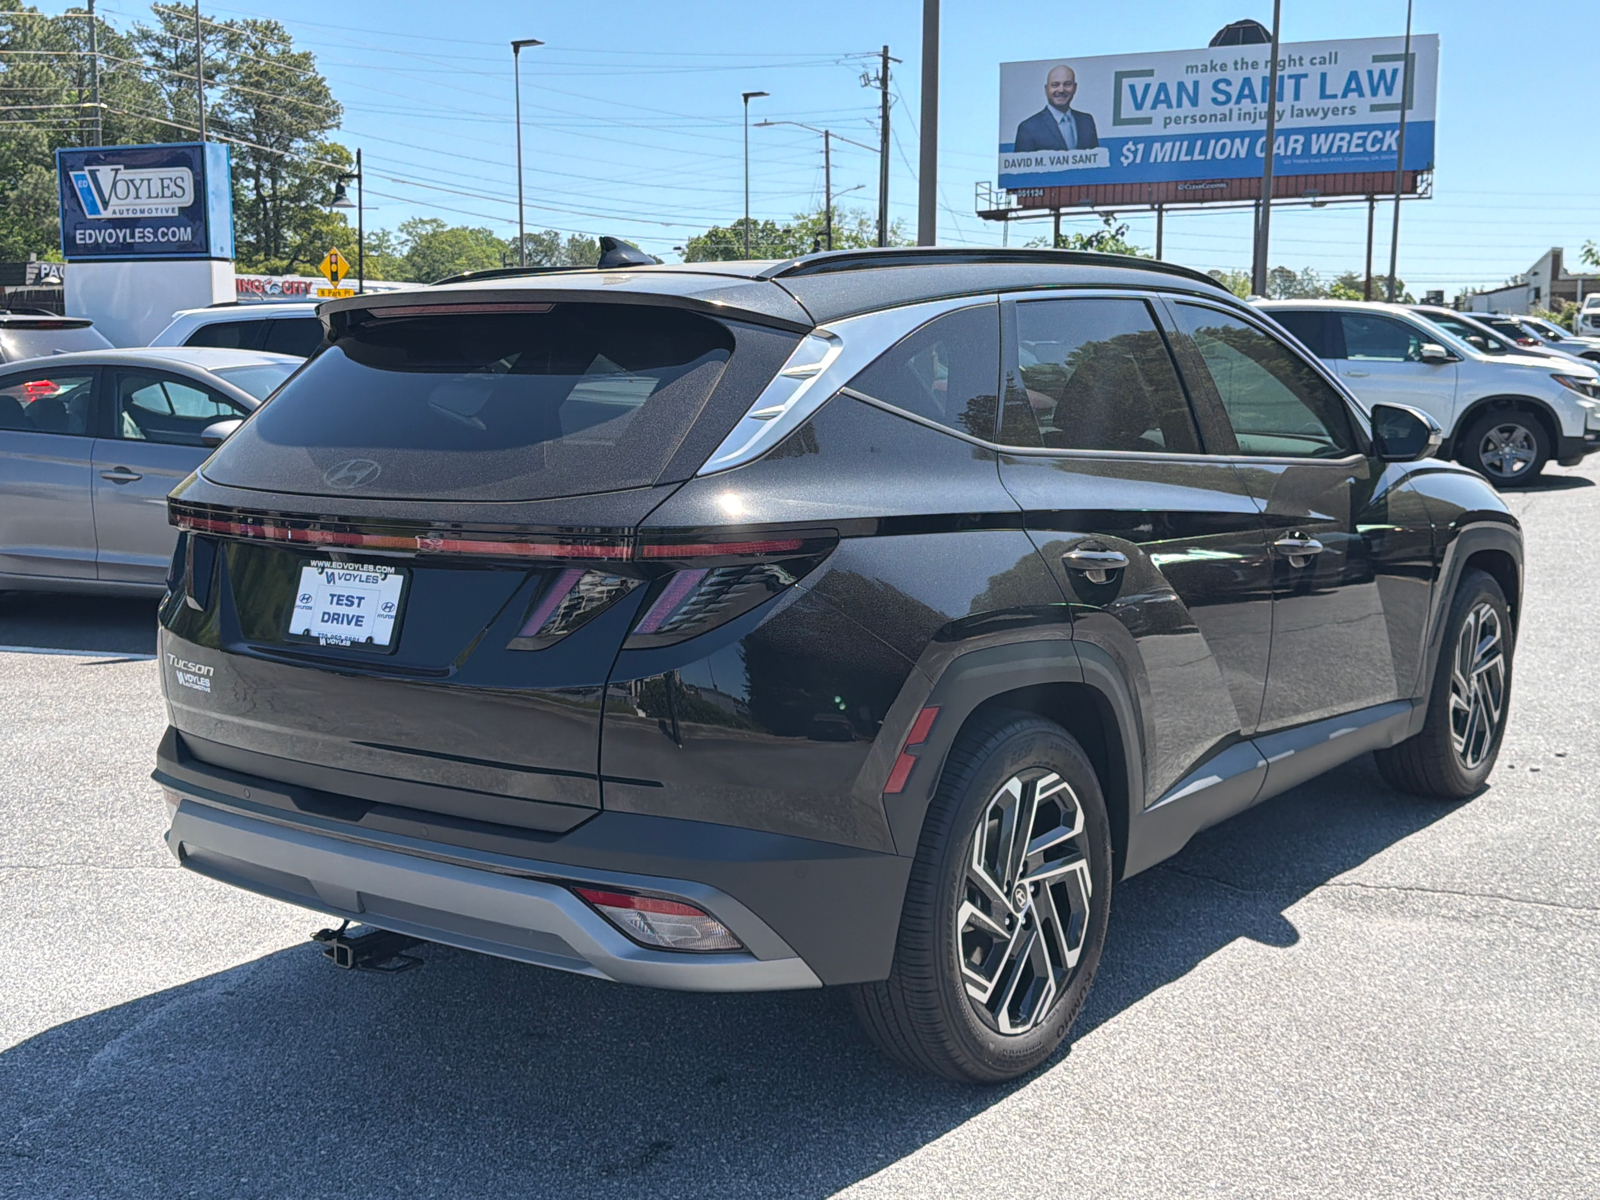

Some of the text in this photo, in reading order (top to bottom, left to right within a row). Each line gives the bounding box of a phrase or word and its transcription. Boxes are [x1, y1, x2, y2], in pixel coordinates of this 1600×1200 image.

[1185, 51, 1338, 74] make the rght call
[1128, 68, 1399, 111] VAN SANT LAW
[1163, 104, 1357, 129] personal injuy lawyers
[1120, 140, 1145, 167] $1
[1149, 137, 1250, 163] MILLION
[1310, 130, 1400, 155] WRECK
[1003, 153, 1099, 169] DAVID M. VAN SANT
[78, 167, 186, 212] ED VOYLES
[111, 206, 177, 216] AUTOMOTIVE
[75, 226, 192, 245] EDVOYLES.COM
[282, 280, 313, 295] CITY
[328, 289, 341, 297] Park
[310, 559, 395, 574] WWW.EDVOYLES.COM
[337, 571, 380, 584] VOYLES
[328, 593, 365, 609] TEST
[320, 611, 365, 628] DRIVE
[183, 672, 211, 687] VOYLES
